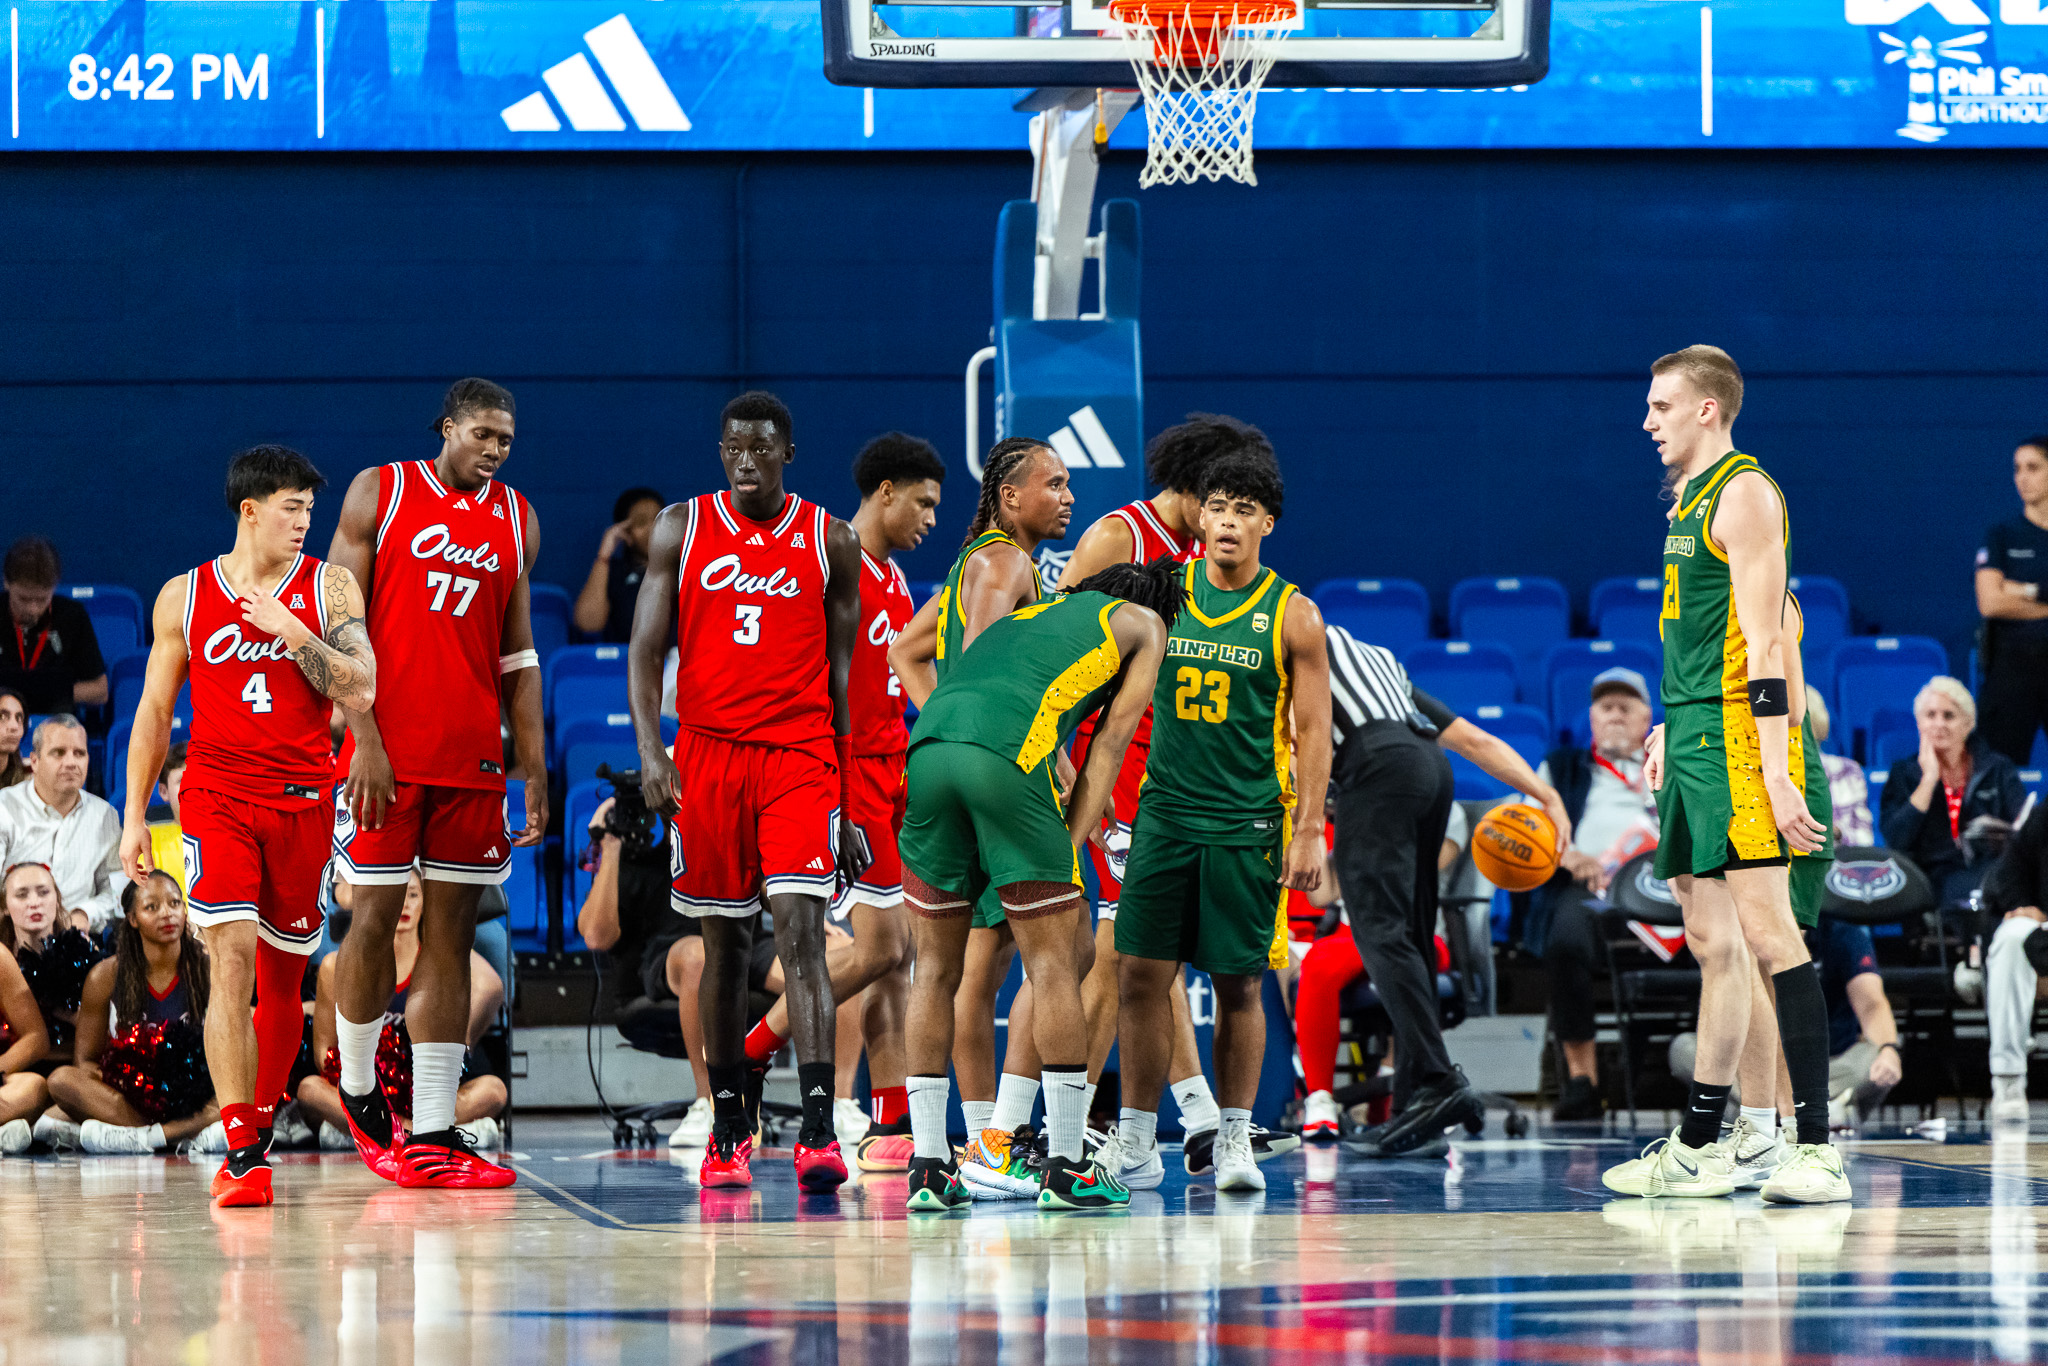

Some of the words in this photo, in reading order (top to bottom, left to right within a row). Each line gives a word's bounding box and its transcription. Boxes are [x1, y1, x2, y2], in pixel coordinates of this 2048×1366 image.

[870, 42, 936, 57] SPALDING
[67, 53, 175, 101] 8:42
[192, 53, 269, 101] PM
[1938, 66, 1996, 95] Phil
[410, 523, 500, 573] Owls
[426, 570, 480, 617] 77
[700, 553, 802, 598] Owls
[1663, 564, 1680, 619] 21
[732, 604, 763, 645] 3
[1166, 637, 1218, 660] AINT
[1218, 643, 1262, 670] LEO
[241, 672, 274, 714] 4
[1175, 666, 1231, 724] 23
